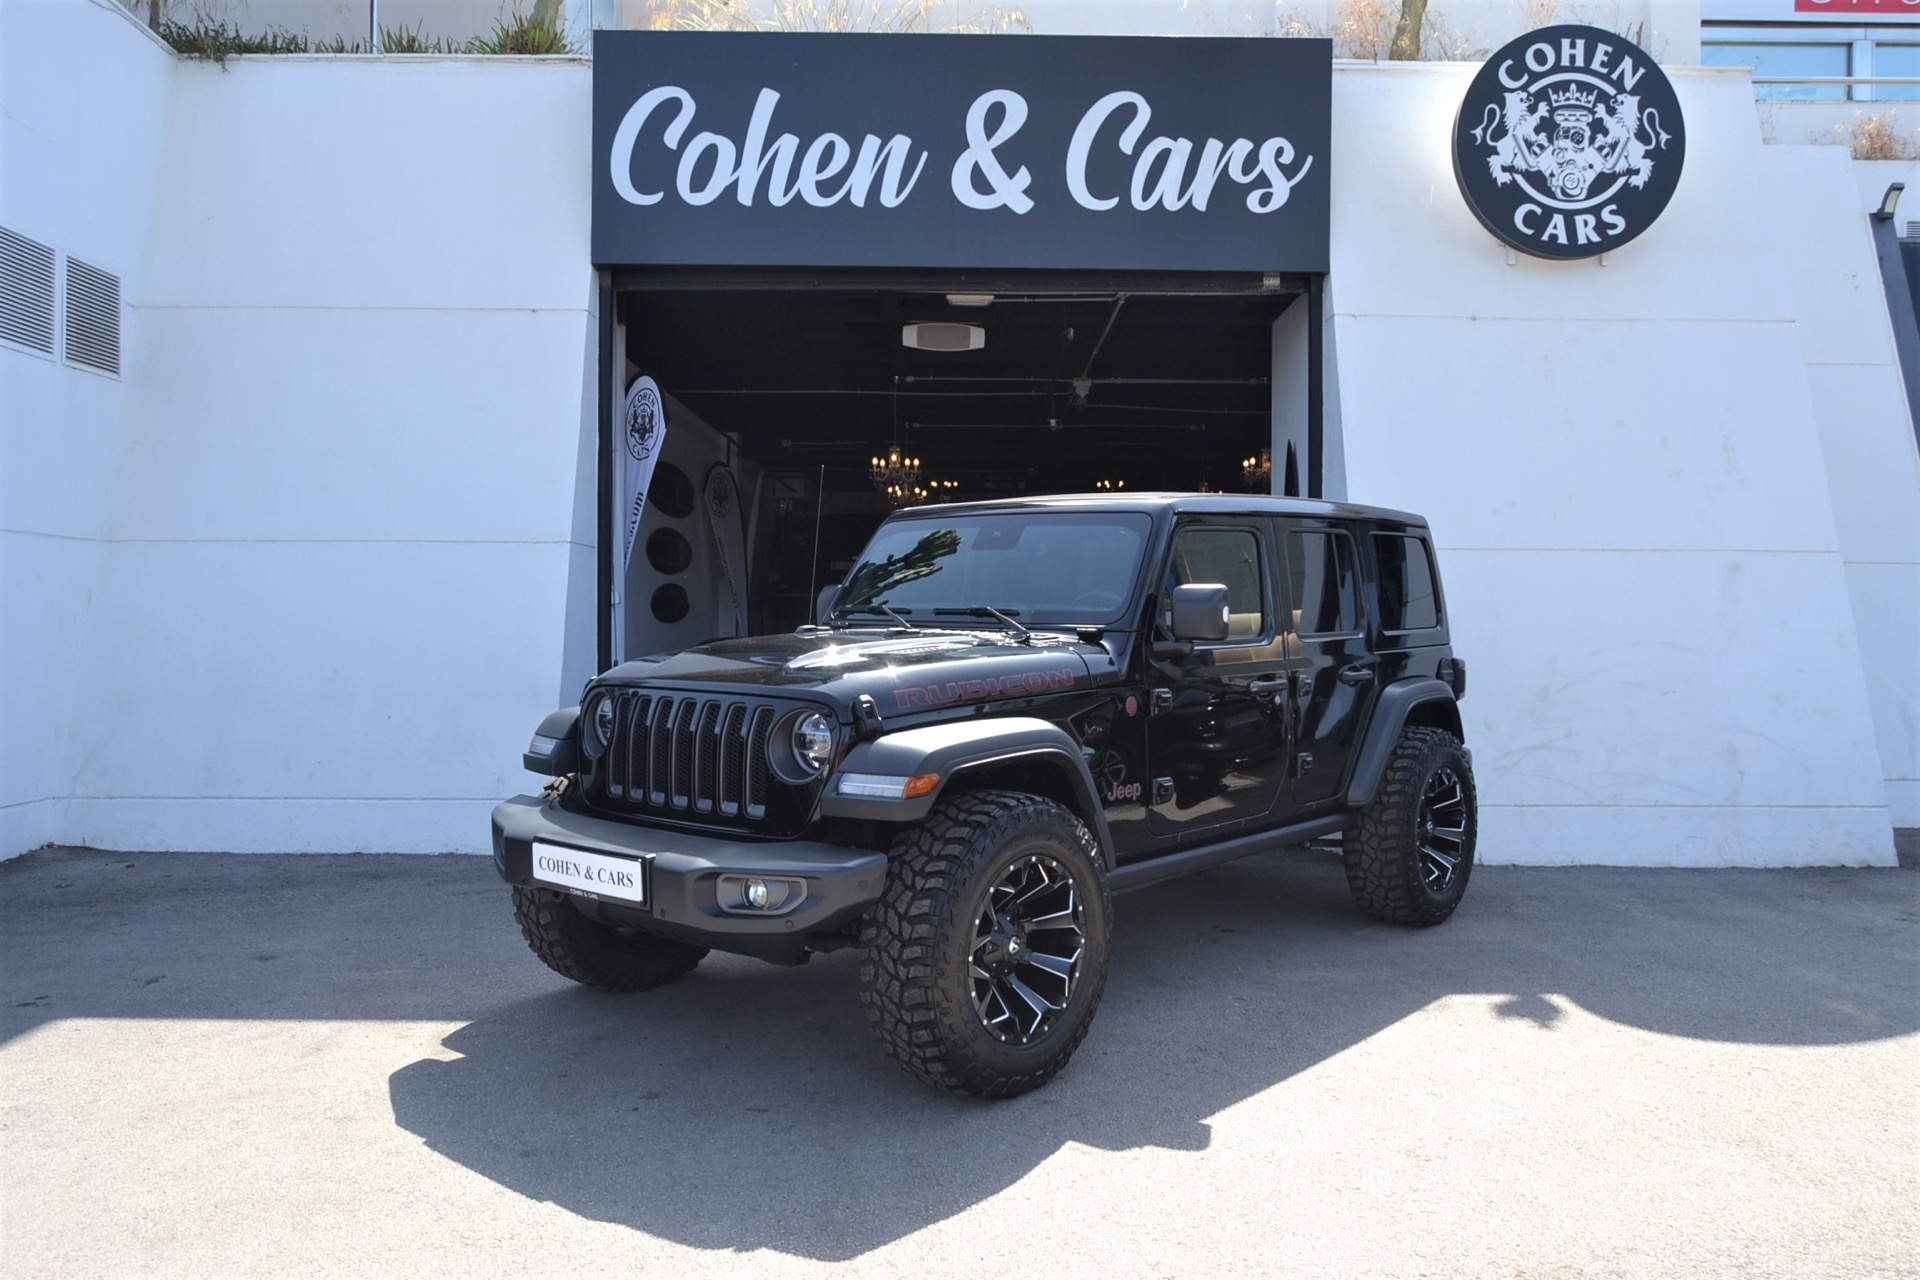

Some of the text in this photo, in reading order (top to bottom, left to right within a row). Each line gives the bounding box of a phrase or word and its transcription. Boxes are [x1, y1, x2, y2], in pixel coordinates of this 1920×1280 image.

[1498, 38, 1646, 91] COHEN
[610, 86, 1314, 215] Cohen & Cars
[1513, 203, 1626, 245] CARS
[632, 391, 656, 409] COHEN
[893, 668, 1075, 708] RUBICON
[1107, 781, 1142, 802] Jeep
[539, 856, 633, 888] COHEN & CARS
